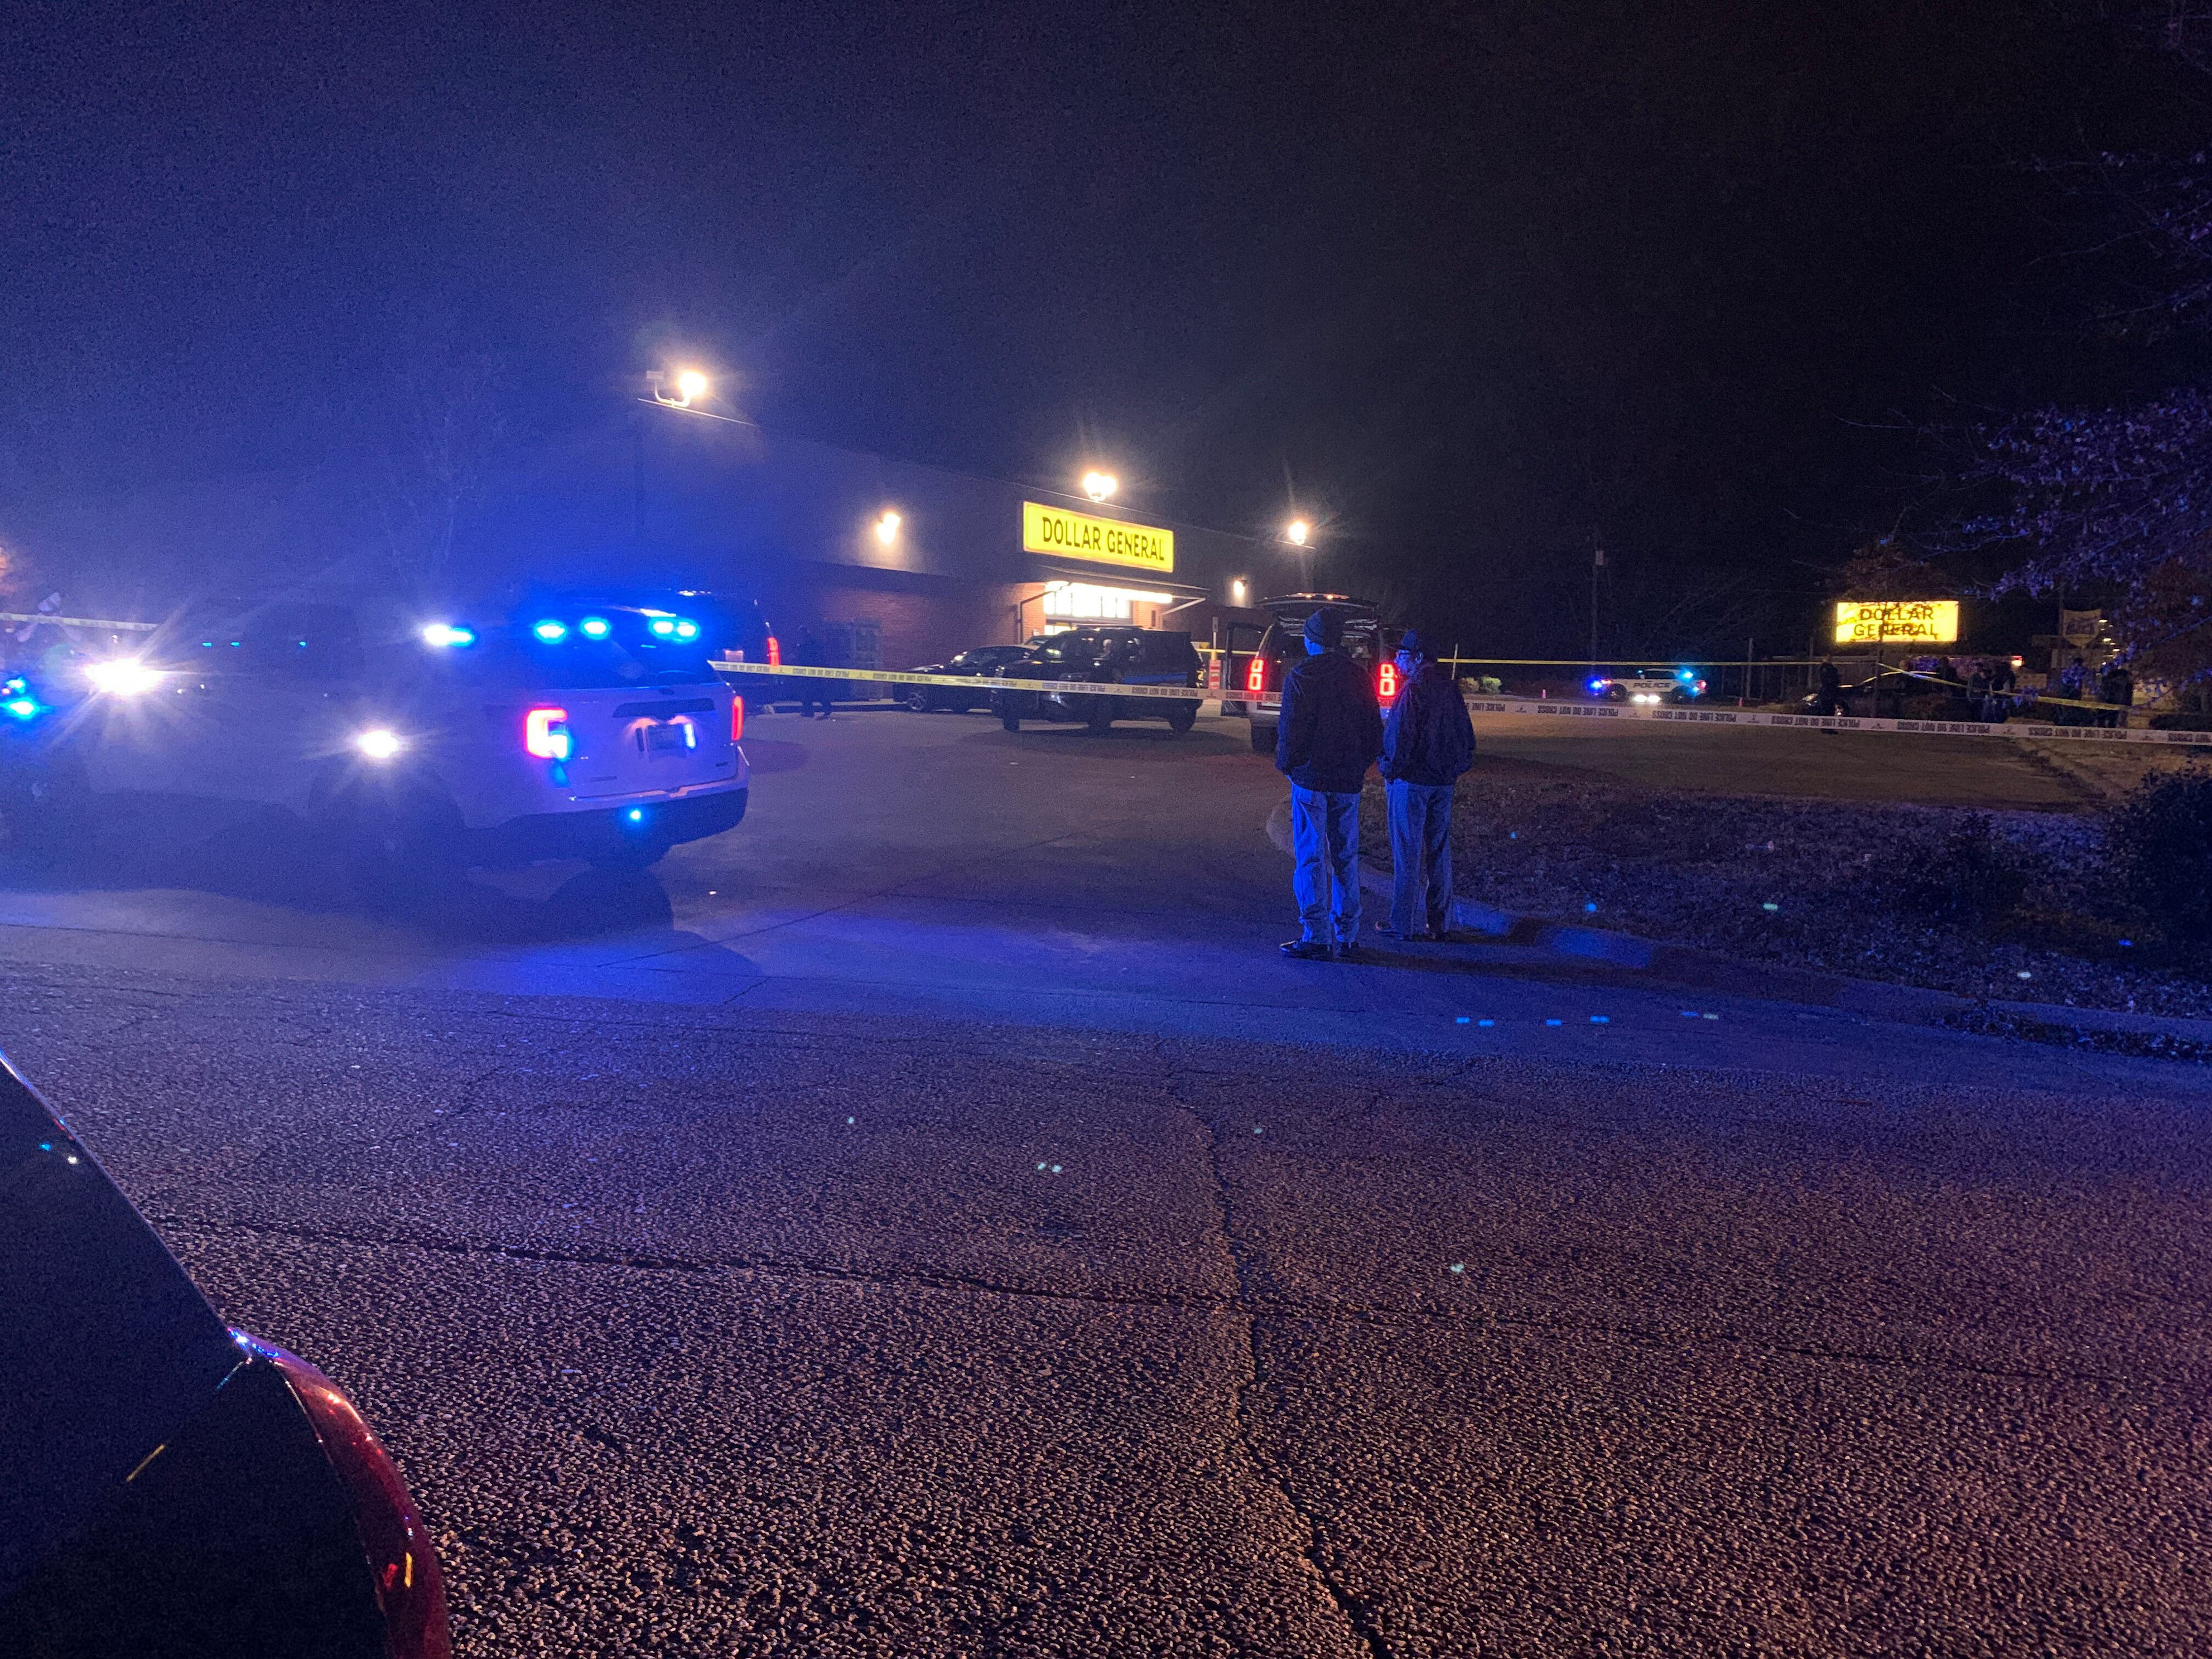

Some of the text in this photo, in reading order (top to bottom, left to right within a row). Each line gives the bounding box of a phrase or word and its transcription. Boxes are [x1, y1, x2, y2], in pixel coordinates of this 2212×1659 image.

[1042, 517, 1164, 561] DOLLAR GENERAL
[1860, 606, 1934, 620] DOLLAR
[1854, 623, 1938, 636] GENERAL
[1538, 705, 1557, 713] CROSS
[1559, 706, 1571, 715] NOT
[1573, 707, 1581, 715] DO
[1583, 707, 1596, 716] LINE
[1652, 711, 1673, 719] CROSS
[1689, 712, 1698, 720] DO
[1700, 712, 1713, 721] LINE
[1714, 713, 1736, 722] POLICE
[1771, 716, 1792, 725] CROSS
[1837, 719, 1859, 727] POLICE
[1897, 721, 1919, 730] CROSS
[1921, 722, 1935, 731] NOT
[1937, 723, 1946, 731] DO
[1966, 725, 1989, 733] POLICE
[2028, 727, 2127, 739] POLICE LINE DO NOT CROSS
